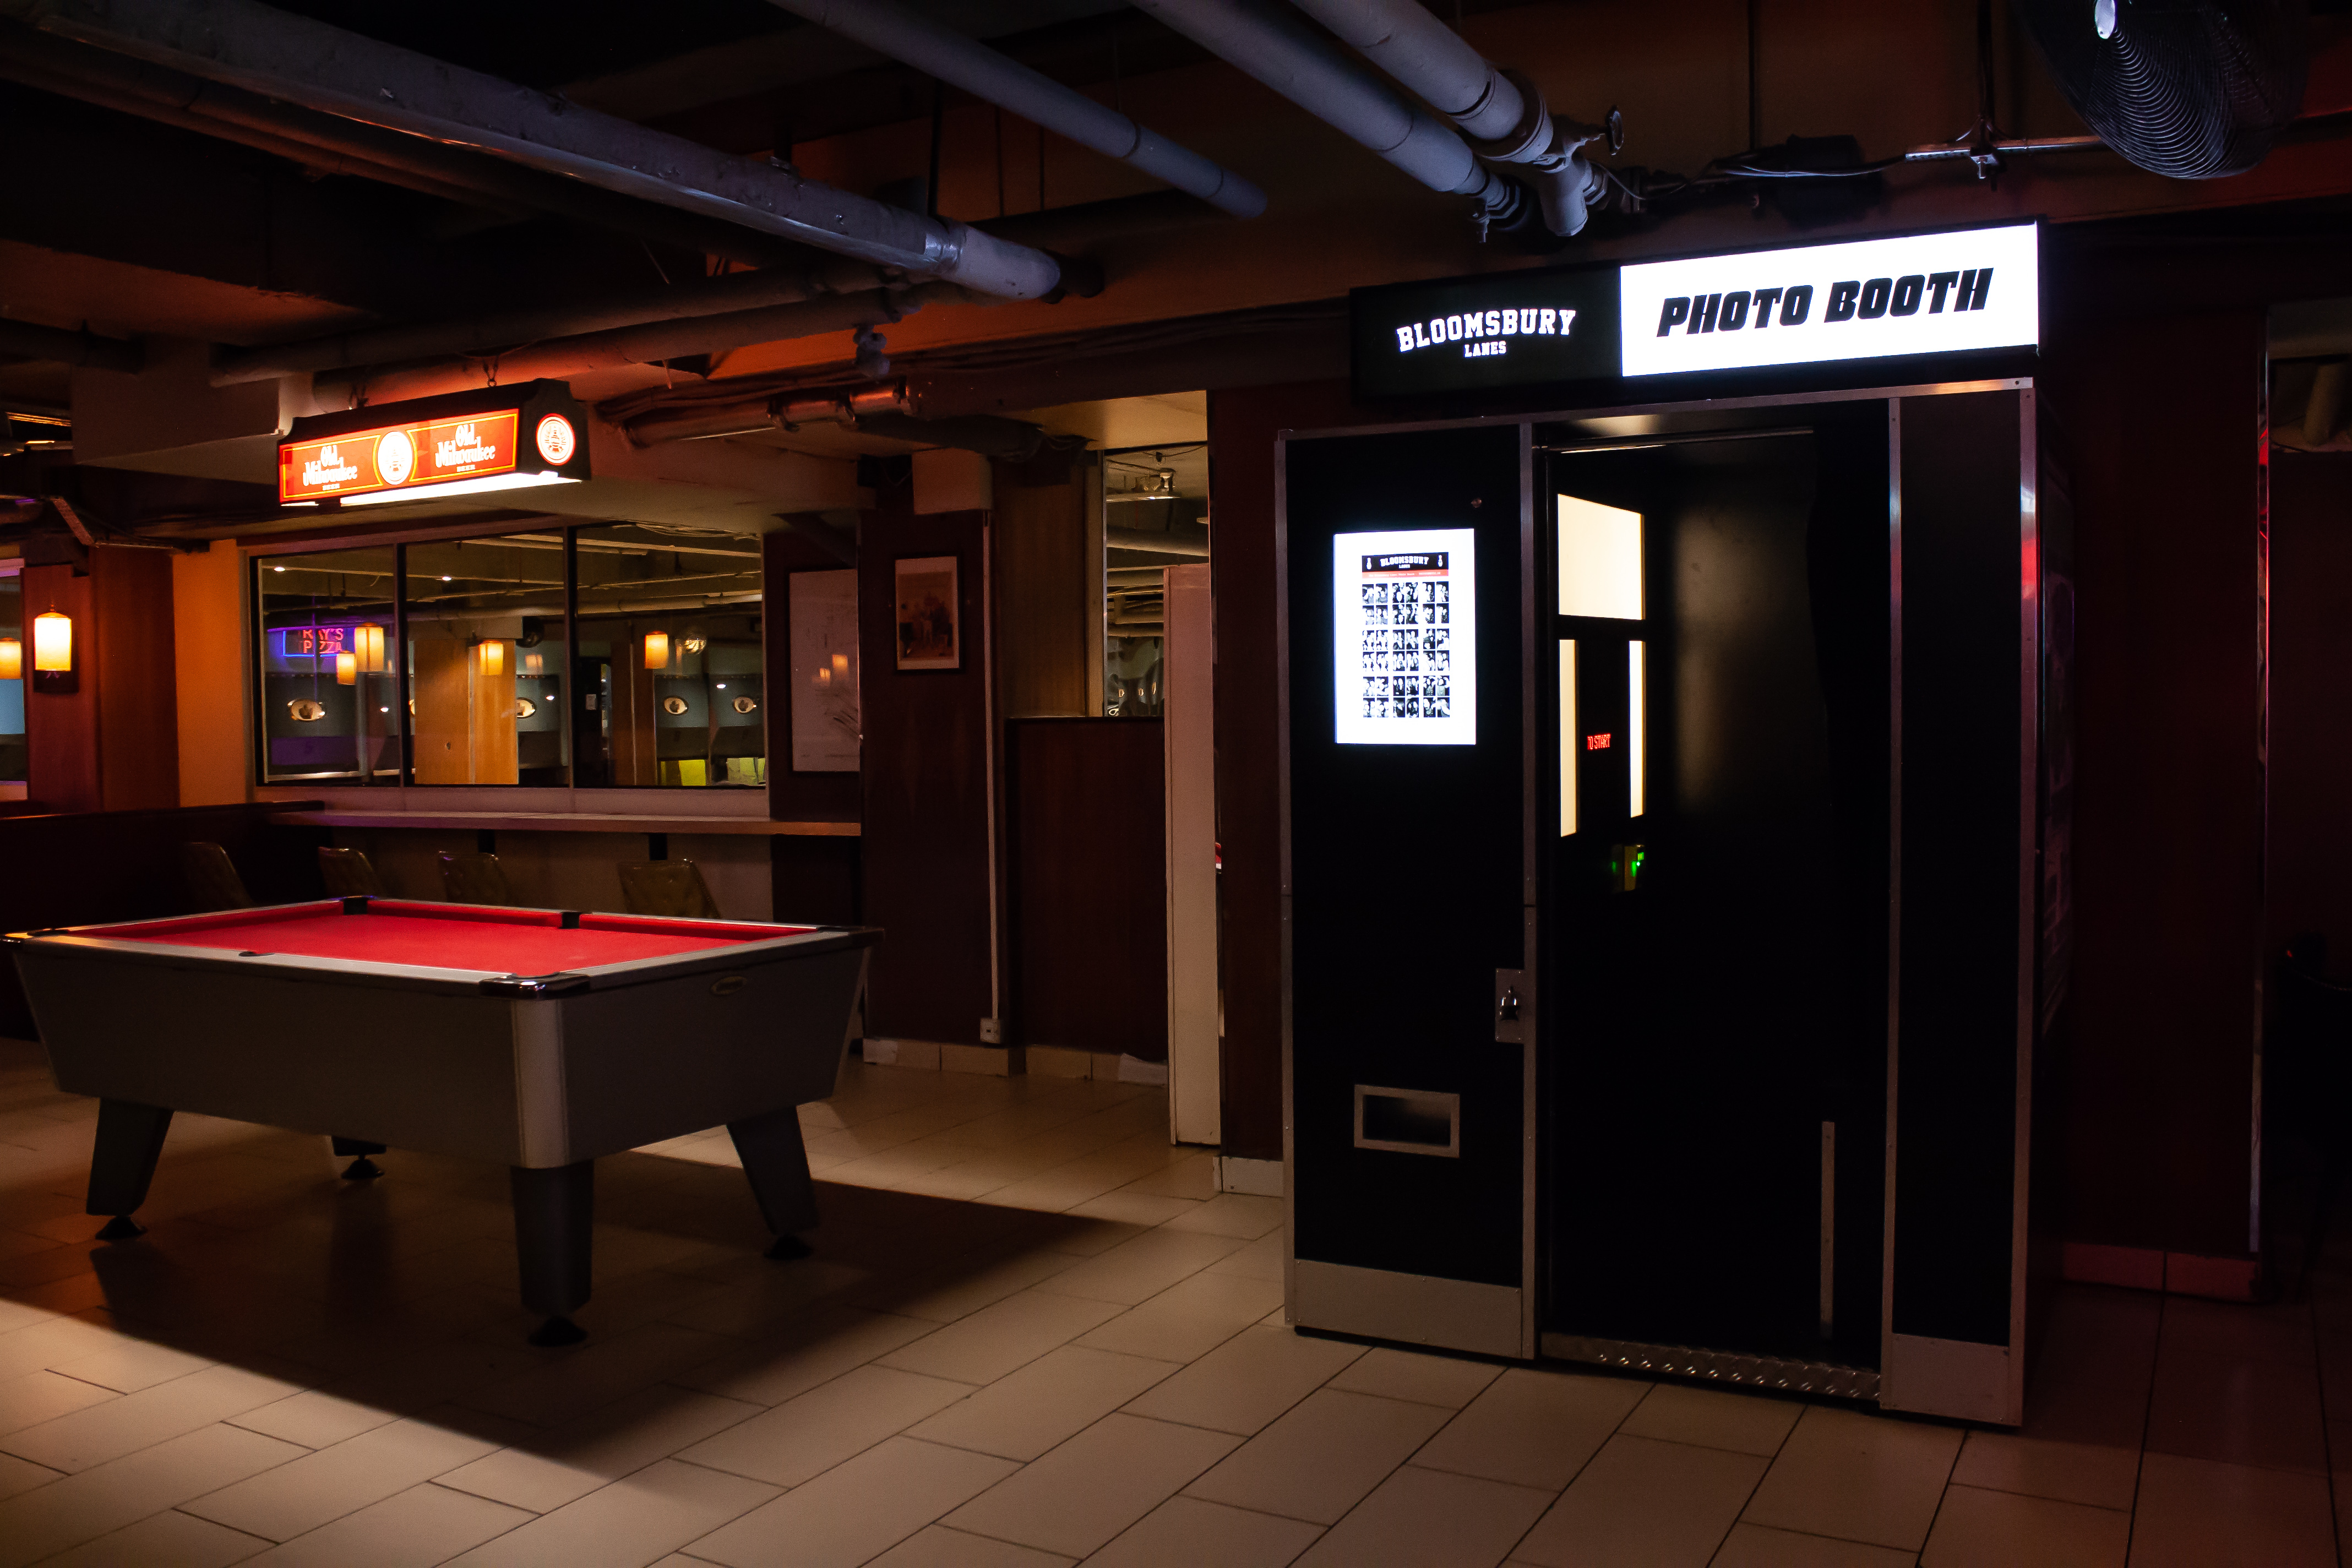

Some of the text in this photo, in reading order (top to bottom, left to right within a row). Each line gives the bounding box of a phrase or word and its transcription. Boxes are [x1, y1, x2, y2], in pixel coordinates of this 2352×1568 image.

[1657, 268, 1994, 337] PHOTO BOOTH
[1396, 308, 1576, 352] BLOOMSBURY
[1463, 340, 1507, 358] LANES
[455, 423, 477, 447] Old
[320, 444, 340, 467] Old
[435, 436, 496, 468] Milwaukee
[302, 457, 358, 486] Milwaukee
[1380, 556, 1429, 567] BLOOMSBURY
[1594, 733, 1611, 749] START
